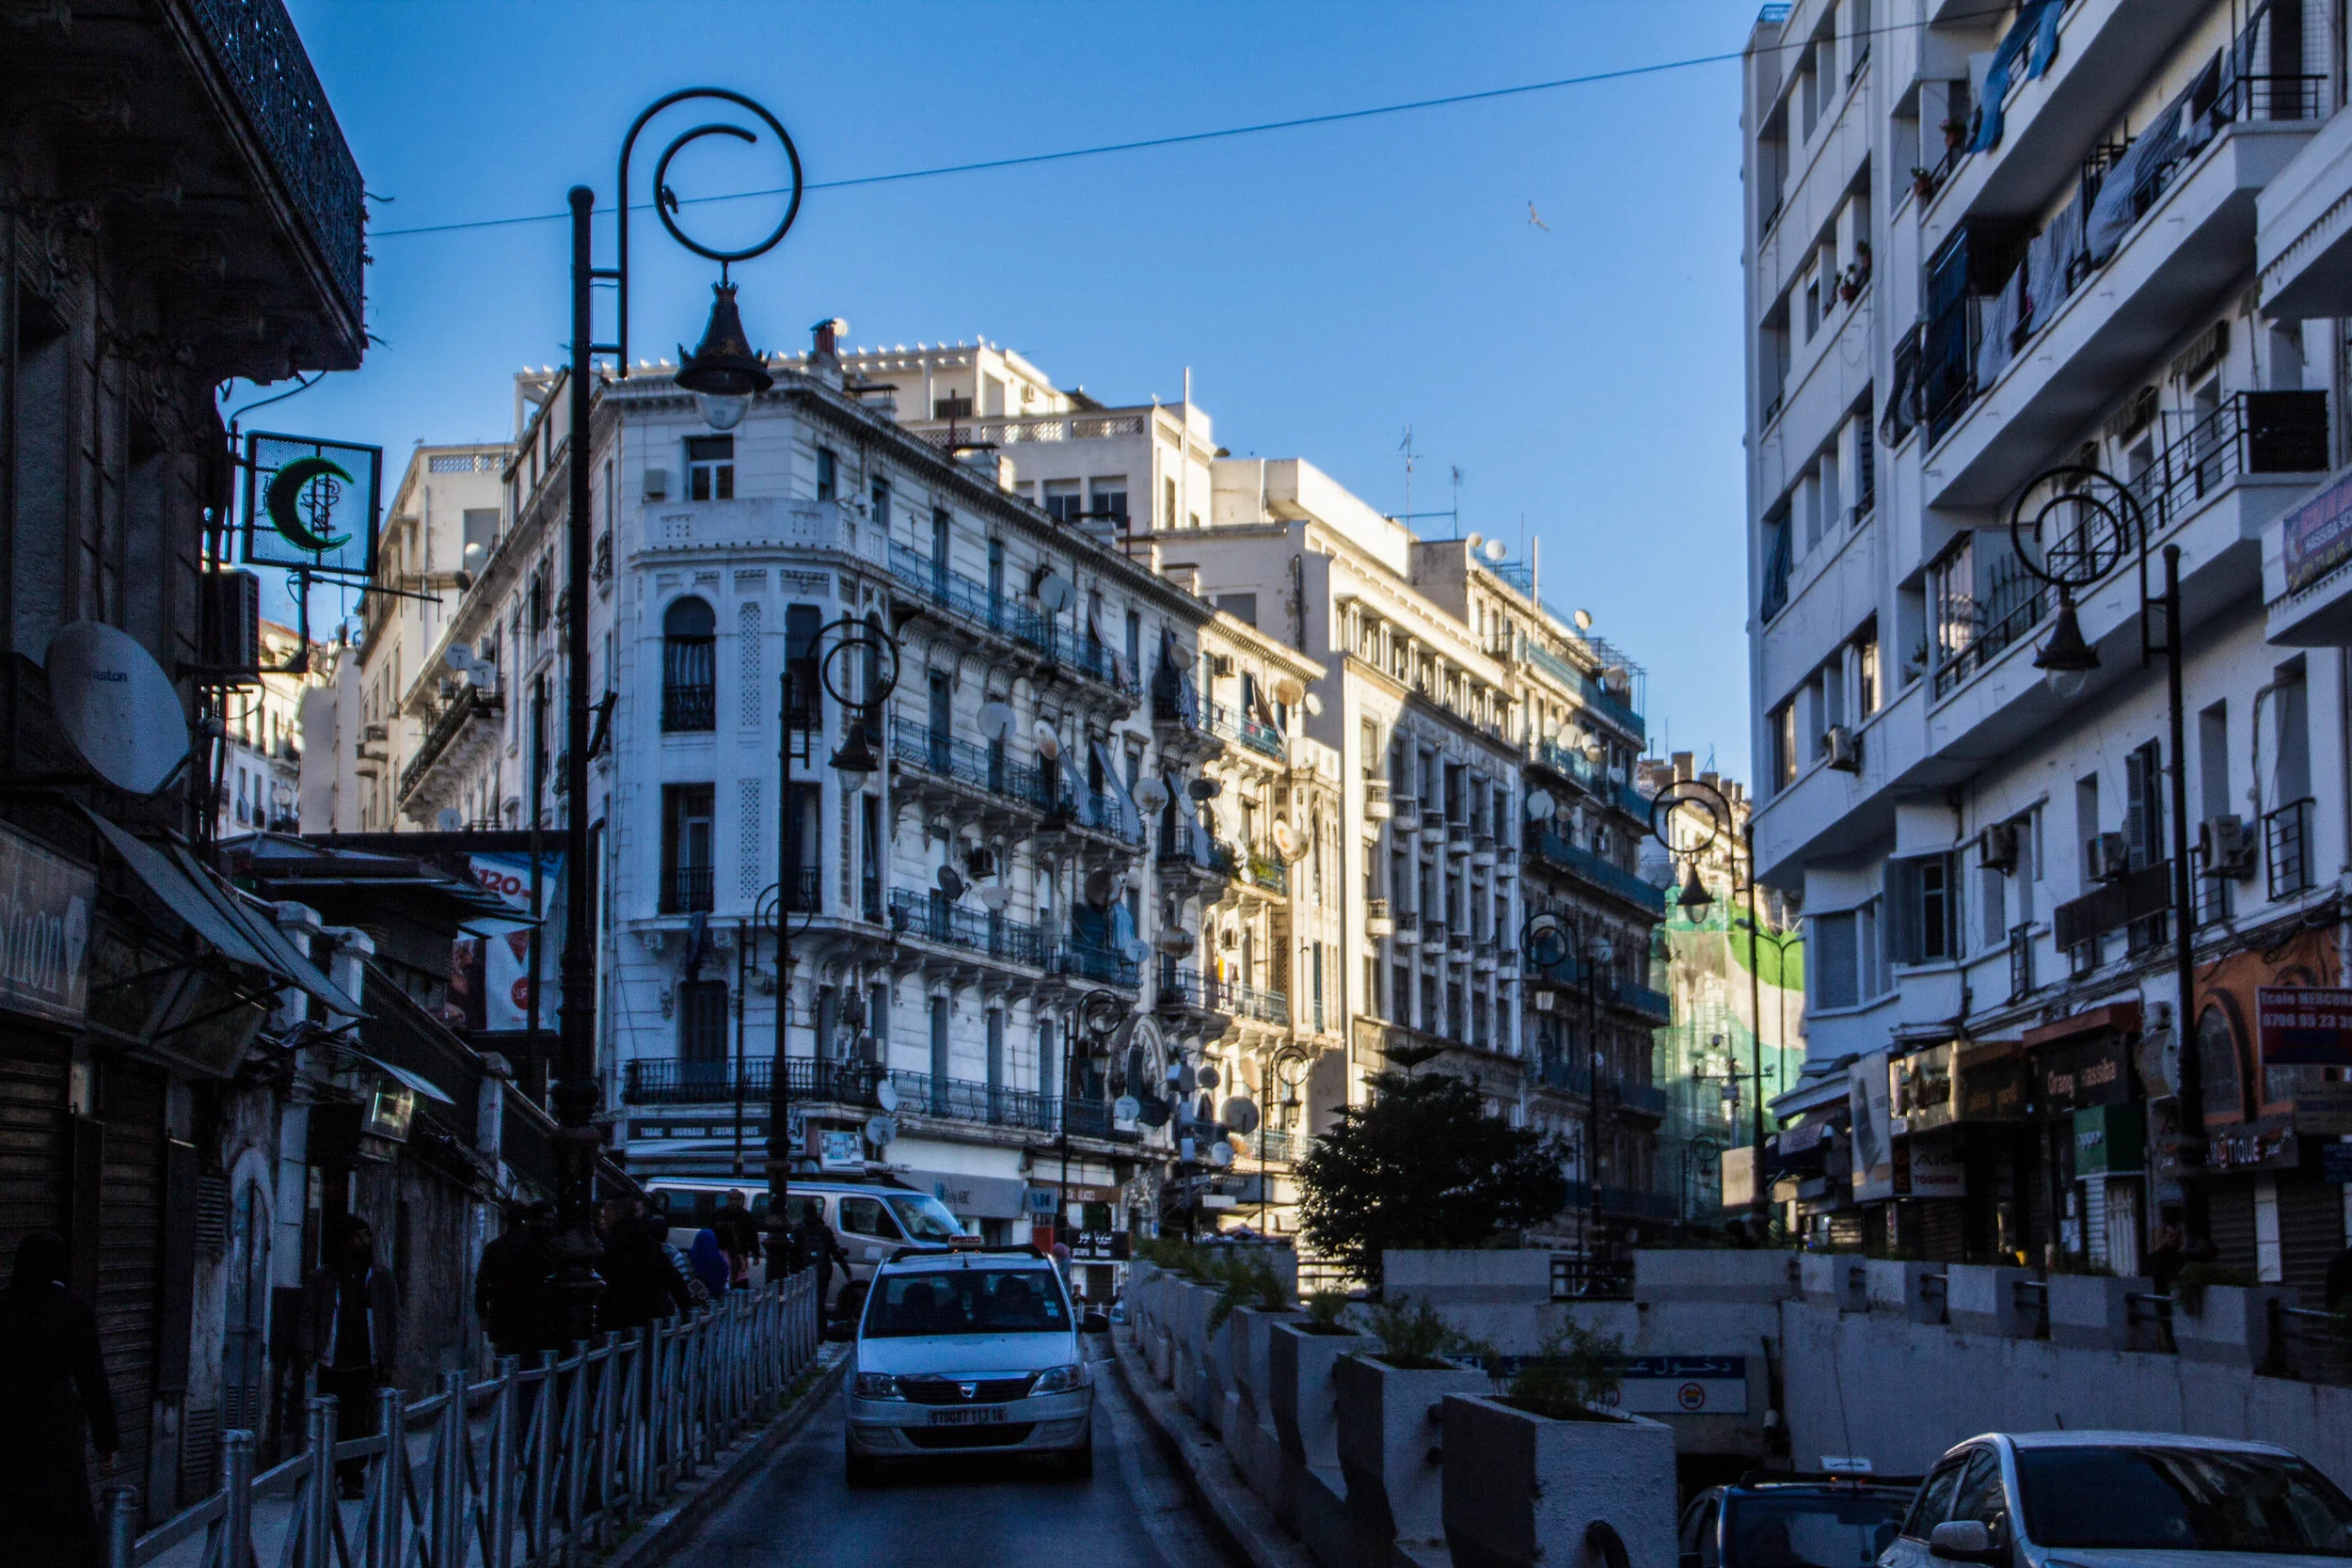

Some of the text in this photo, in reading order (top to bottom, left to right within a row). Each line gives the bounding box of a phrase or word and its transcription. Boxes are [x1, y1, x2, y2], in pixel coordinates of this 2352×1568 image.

[640, 1127, 663, 1138] TABAC
[711, 1125, 760, 1137] COSMEQUES
[1914, 1174, 1960, 1185] TOSHIBA
